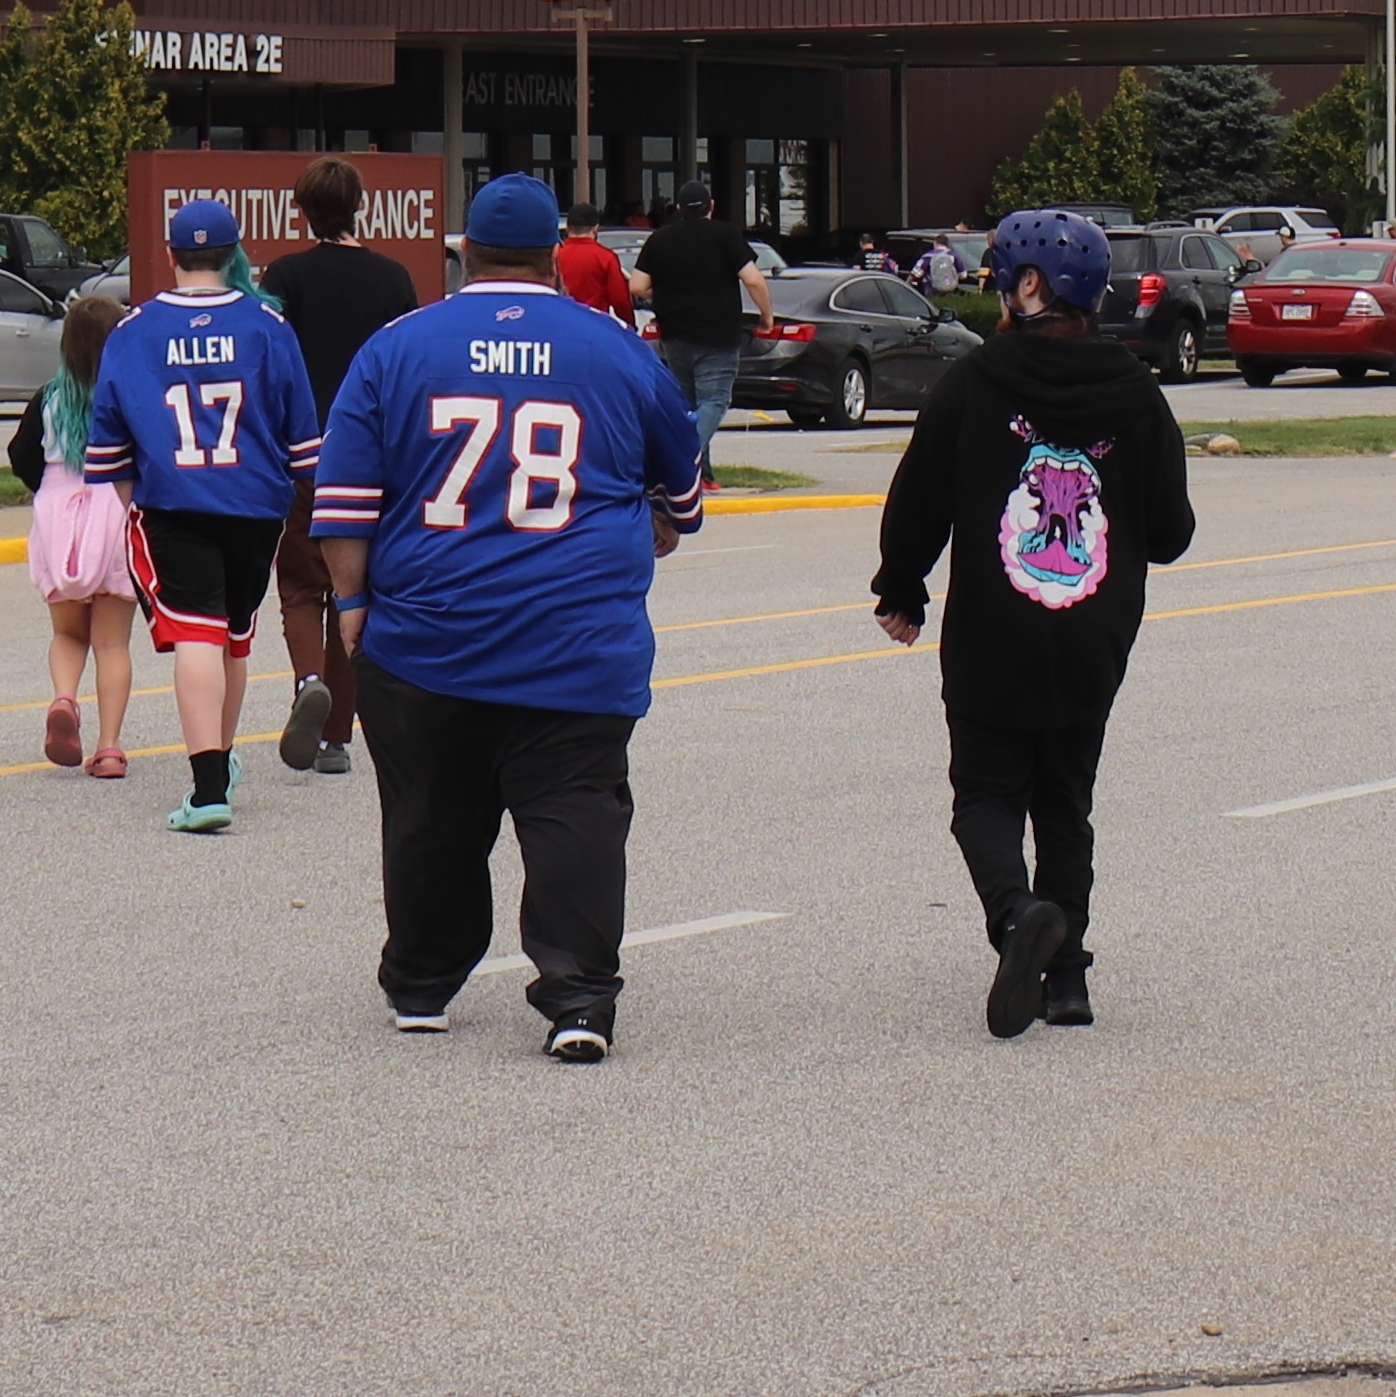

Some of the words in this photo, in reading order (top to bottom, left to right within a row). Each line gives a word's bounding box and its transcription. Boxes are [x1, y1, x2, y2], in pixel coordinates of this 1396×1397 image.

[188, 32, 249, 72] AREA
[256, 34, 283, 73] 2E
[465, 71, 497, 105] AST
[164, 188, 300, 240] EUTIVE
[307, 189, 435, 240] RANCE
[166, 335, 235, 366] ALLEN
[469, 339, 552, 376] SMITH
[164, 379, 245, 469] 17
[422, 394, 584, 533] 78
